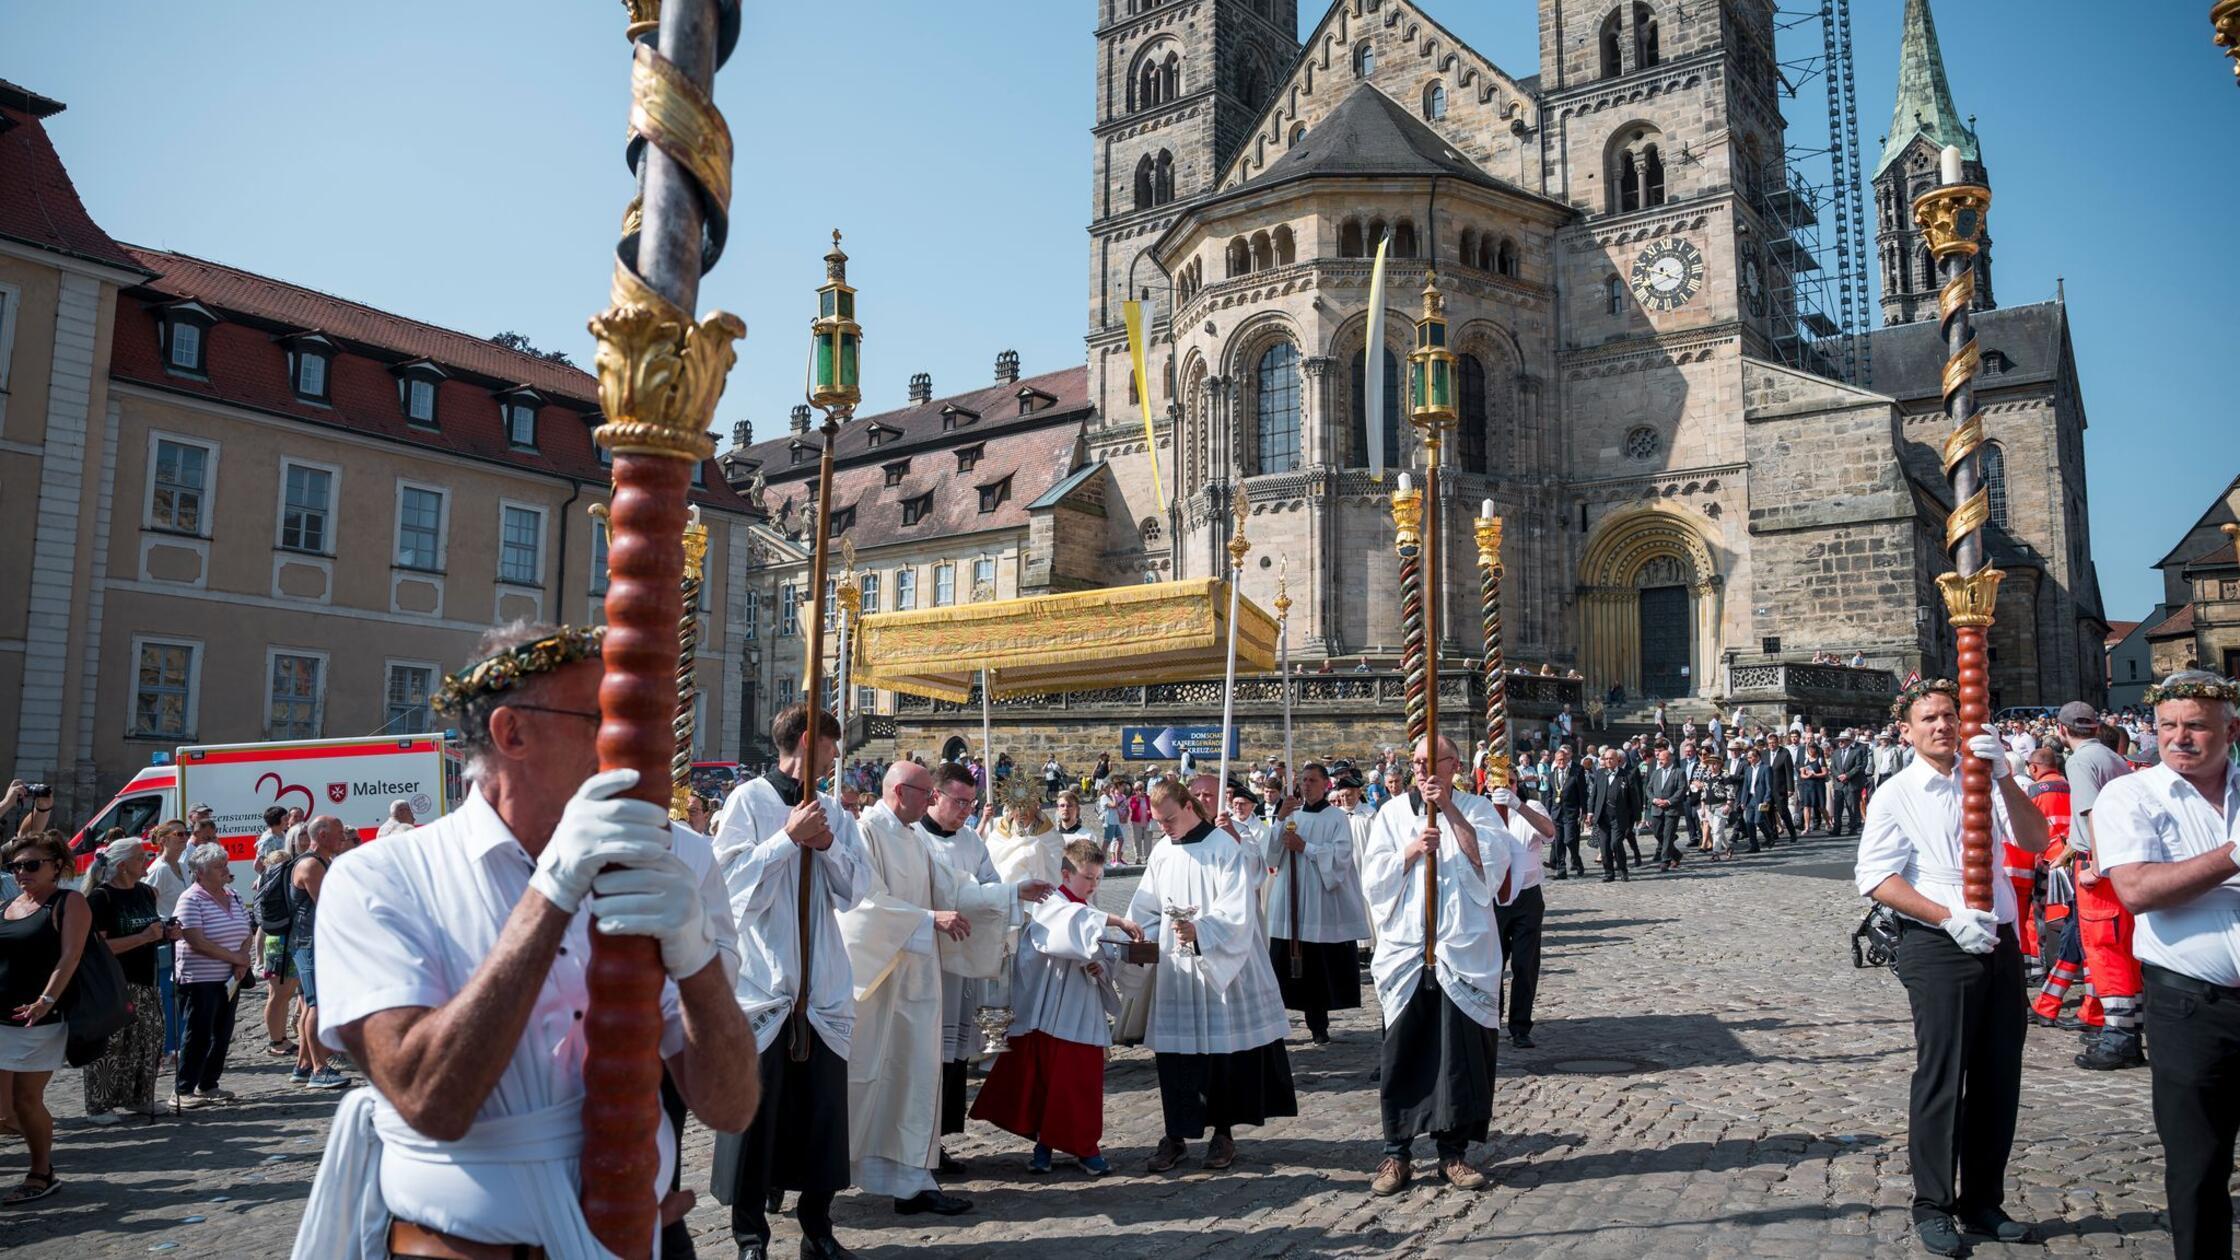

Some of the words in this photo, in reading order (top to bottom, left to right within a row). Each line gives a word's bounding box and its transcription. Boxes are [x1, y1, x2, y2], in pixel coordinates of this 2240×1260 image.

[1660, 238, 1672, 250] XII
[1678, 241, 1685, 251] I
[1687, 250, 1699, 260] II
[1635, 260, 1645, 269] X
[1691, 264, 1703, 274] III
[1687, 278, 1701, 291] IIII
[353, 780, 420, 796] Malteser
